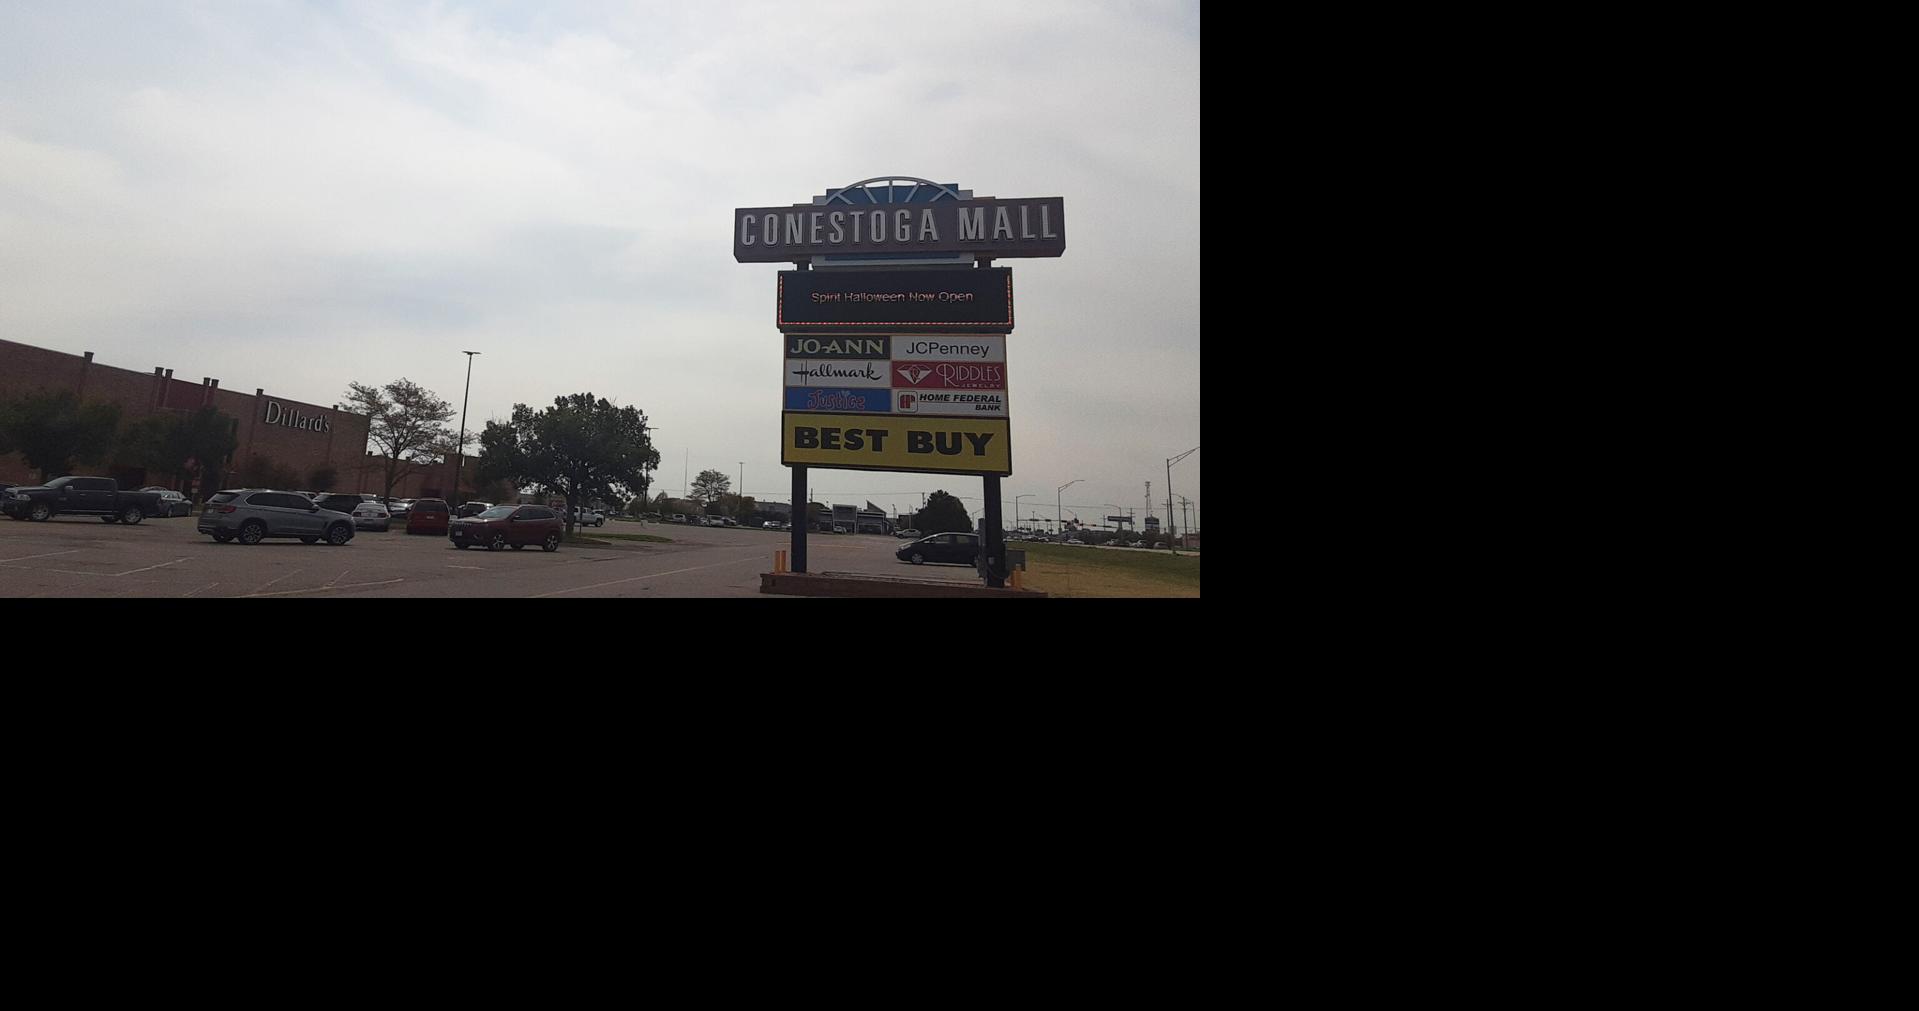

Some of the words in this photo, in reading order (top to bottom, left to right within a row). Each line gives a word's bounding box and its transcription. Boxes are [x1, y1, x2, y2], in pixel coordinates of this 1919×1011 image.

[742, 208, 938, 246] CONESTOGA
[959, 204, 1057, 241] MALL
[812, 292, 841, 304] Spirit
[844, 292, 905, 302] Halloween
[909, 292, 934, 302] Now
[938, 291, 974, 303] Open
[906, 341, 990, 358] JCPenney
[792, 360, 882, 386] Hallmark
[936, 363, 1002, 387] RIDDLES
[919, 393, 951, 402] HOME
[953, 394, 1002, 403] FEDERAL
[975, 404, 1001, 412] BANK
[265, 400, 330, 433] Dillard's
[794, 426, 889, 452] BEST
[907, 430, 994, 456] BUY
